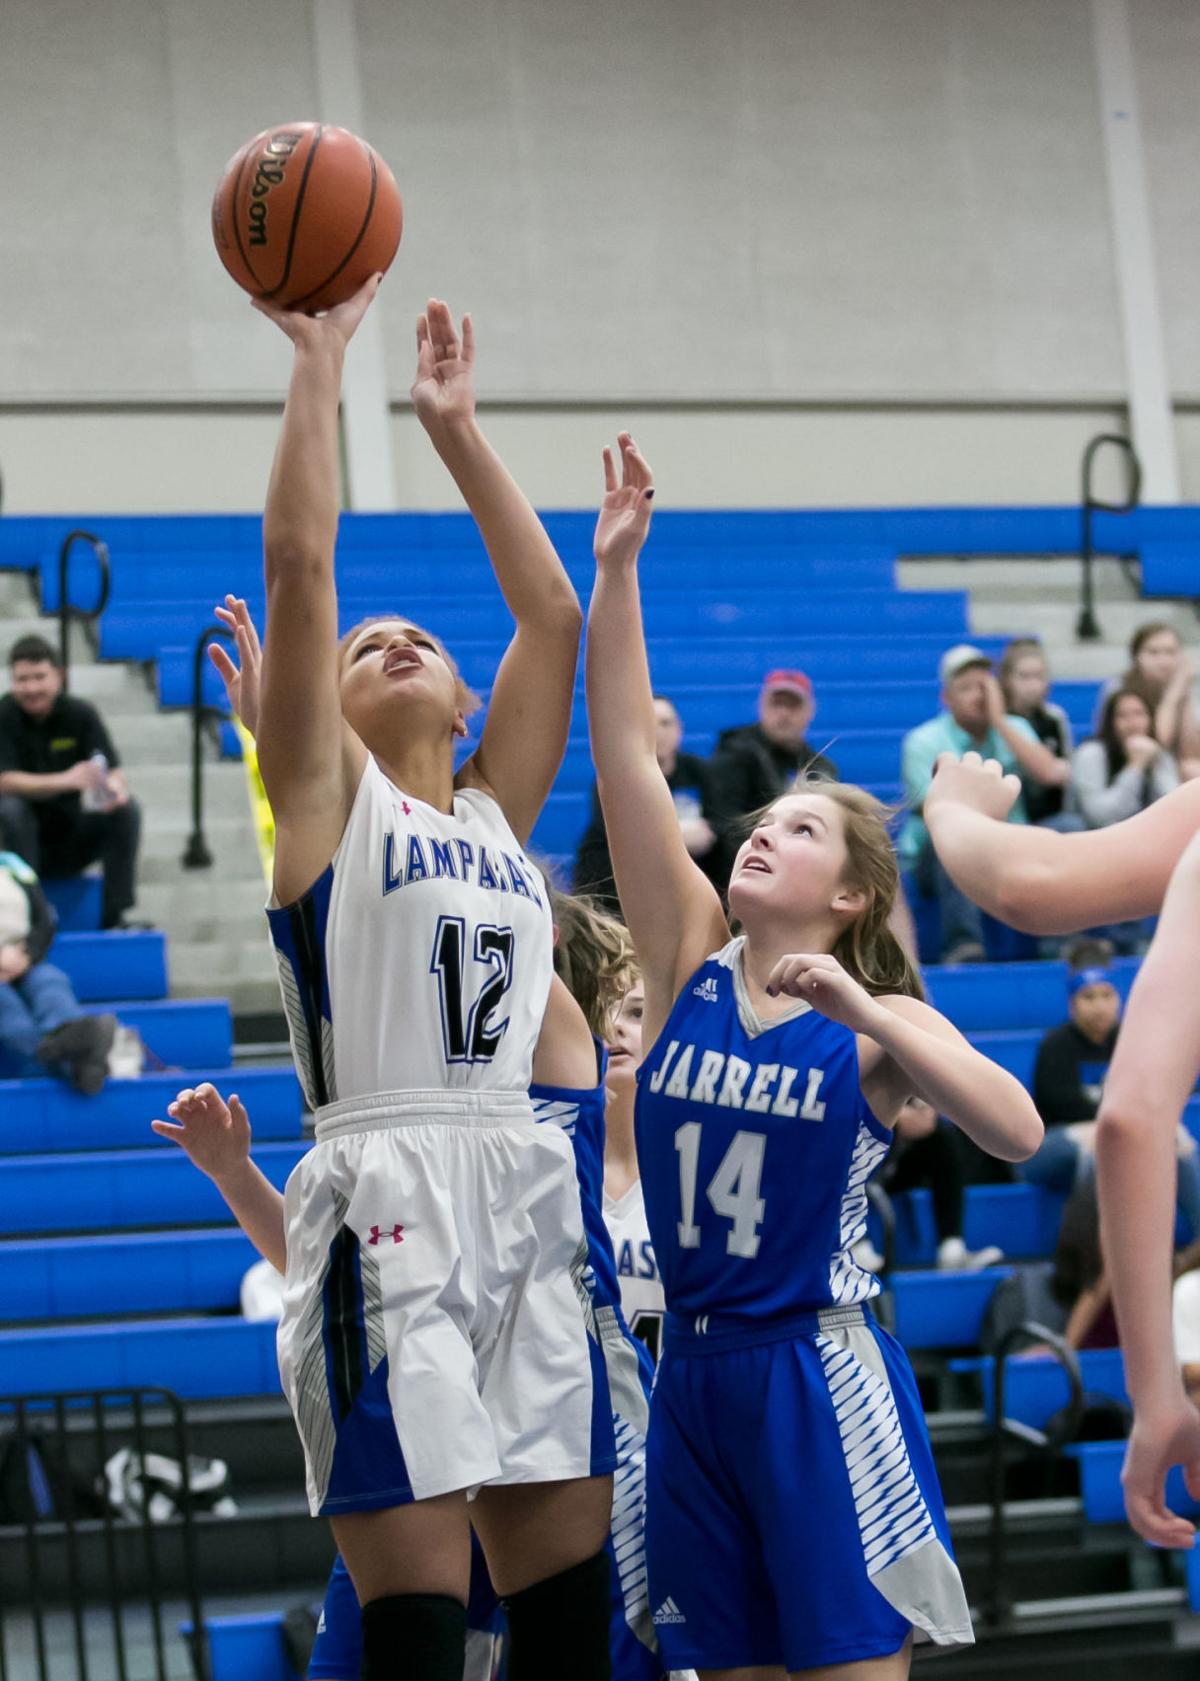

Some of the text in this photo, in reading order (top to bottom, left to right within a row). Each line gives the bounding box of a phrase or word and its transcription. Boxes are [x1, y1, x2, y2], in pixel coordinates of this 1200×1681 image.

[429, 914, 515, 1065] 12
[649, 1039, 827, 1122] JARRELL
[674, 1120, 767, 1260] 14
[652, 1614, 686, 1625] adidas
